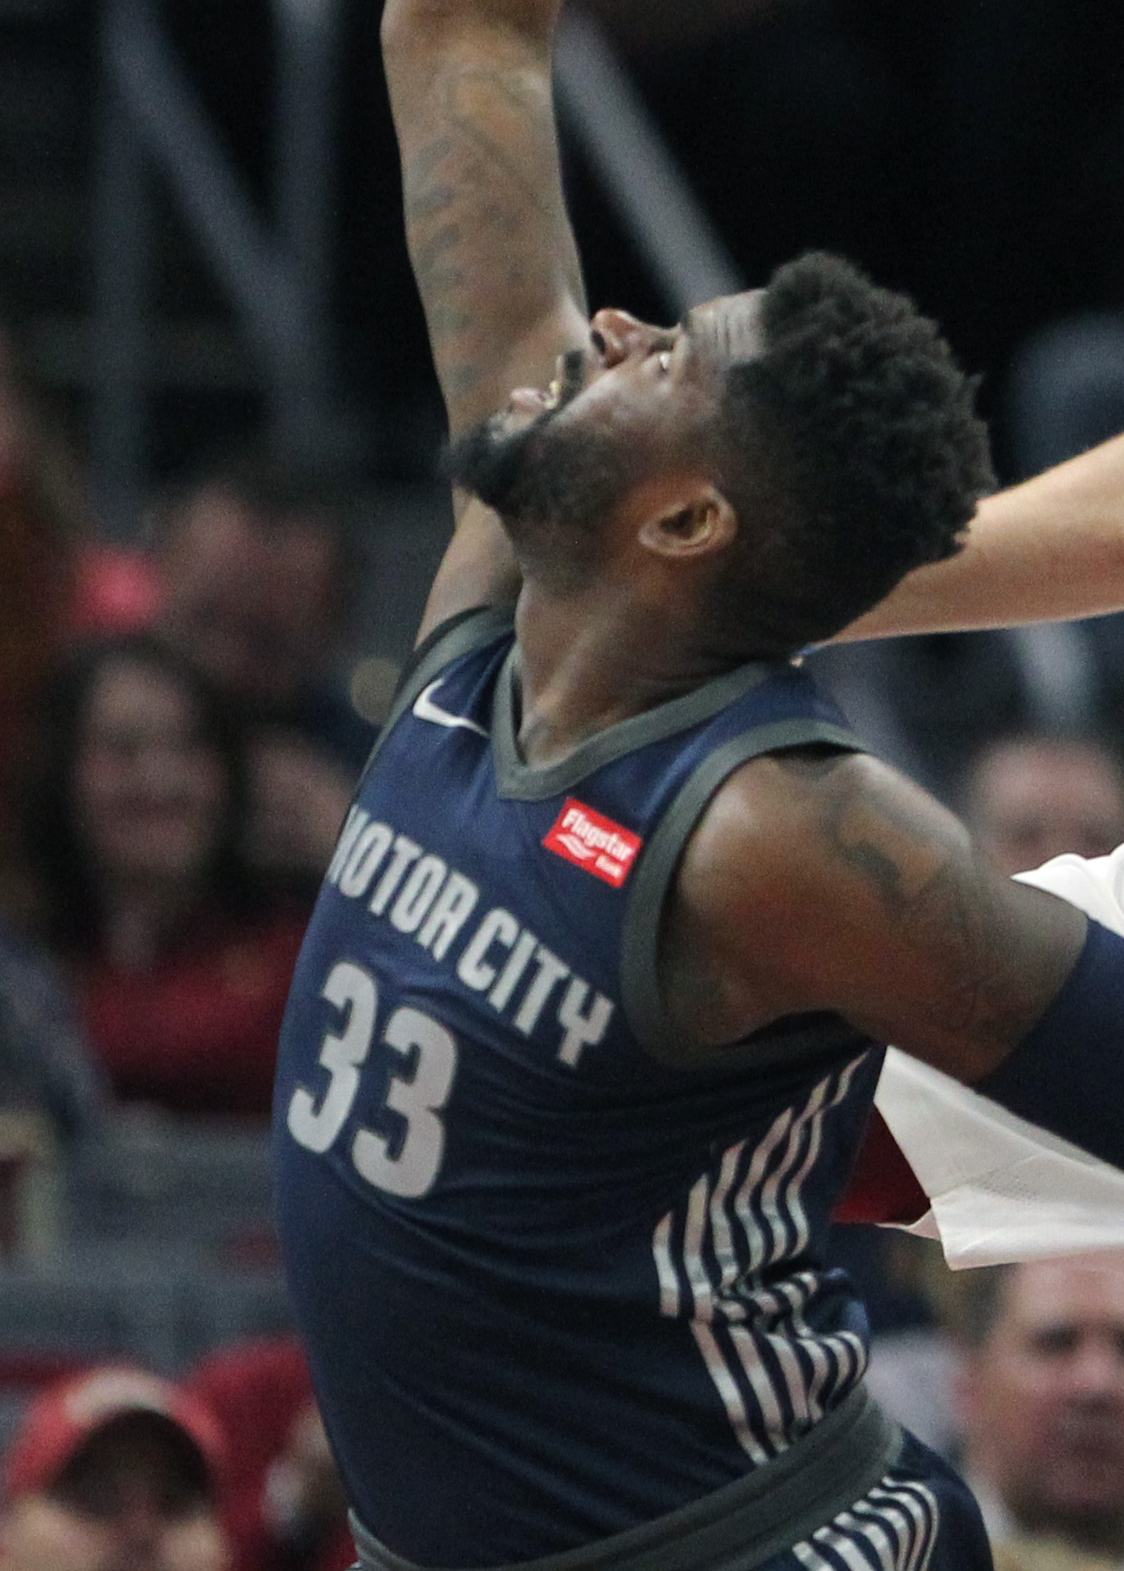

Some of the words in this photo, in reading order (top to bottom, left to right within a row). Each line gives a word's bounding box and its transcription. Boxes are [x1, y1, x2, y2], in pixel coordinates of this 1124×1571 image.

[562, 808, 635, 862] Flagstar
[457, 908, 615, 1068] CITY
[287, 961, 458, 1199] 33
